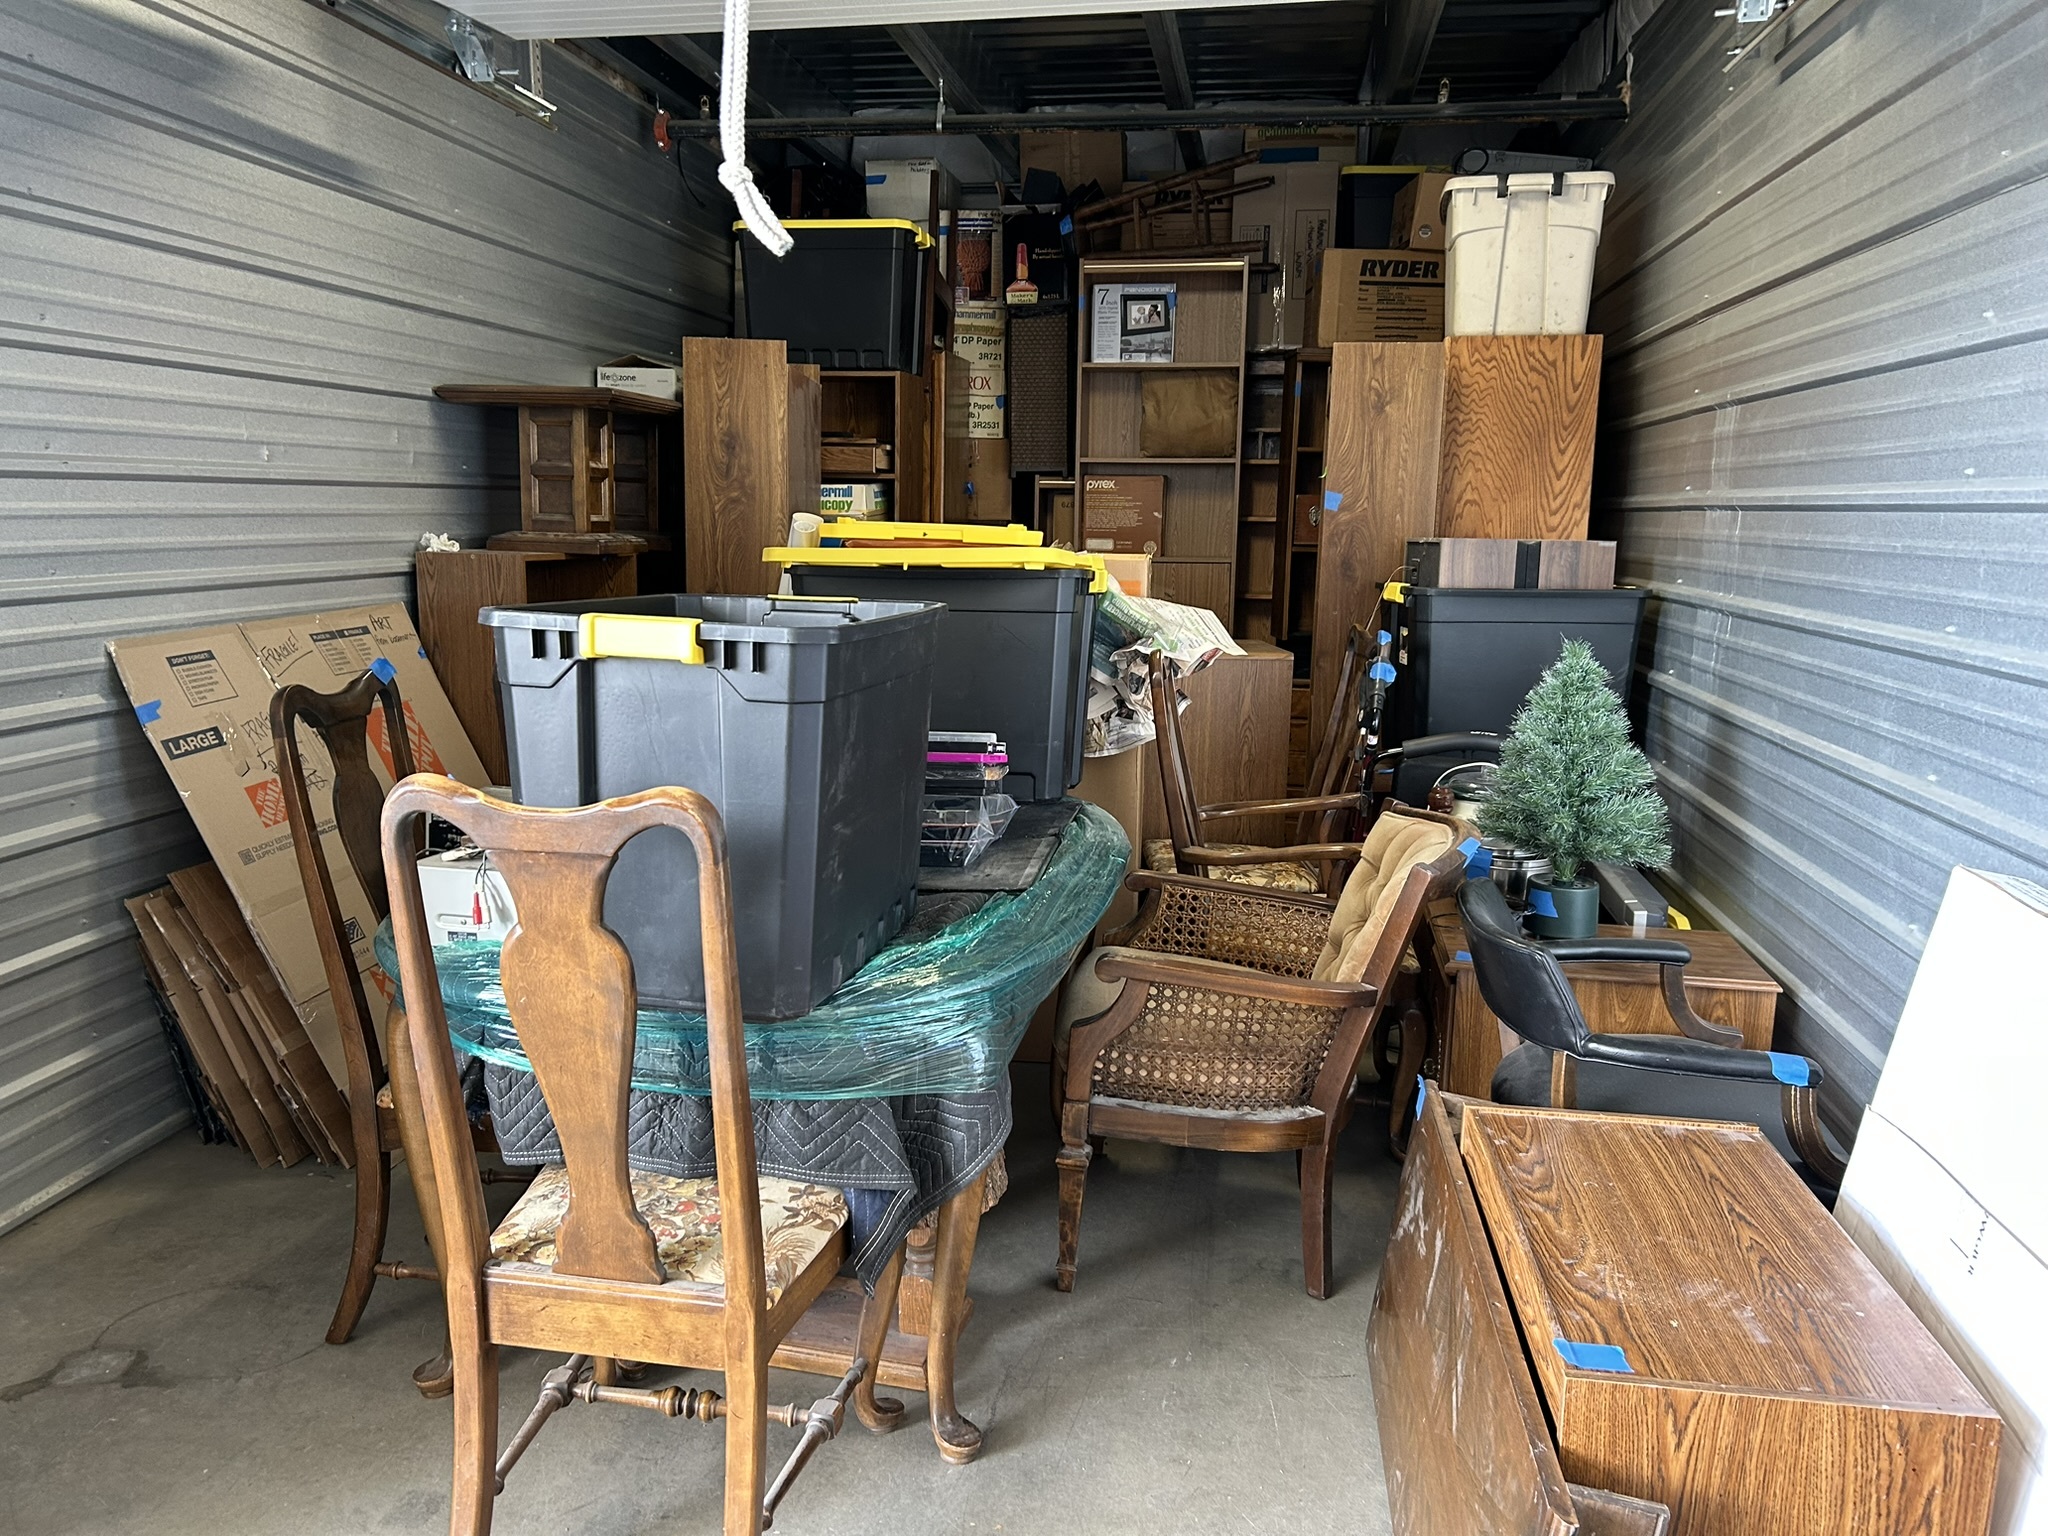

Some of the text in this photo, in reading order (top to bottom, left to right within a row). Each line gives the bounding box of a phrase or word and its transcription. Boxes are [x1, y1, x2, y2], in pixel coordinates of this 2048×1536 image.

[1360, 259, 1440, 278] RYDER
[1097, 288, 1110, 305] 7
[961, 336, 975, 344] DP
[976, 336, 1002, 346] Paper
[978, 353, 1002, 361] 3R721
[968, 376, 992, 390] ROX
[973, 402, 994, 411] Paper
[972, 421, 1000, 429] 3R2531
[821, 486, 853, 498] ermill
[1086, 480, 1116, 491] pyrex
[369, 614, 395, 632] ART
[240, 711, 272, 745] FRAG
[168, 731, 219, 755] LARGE
